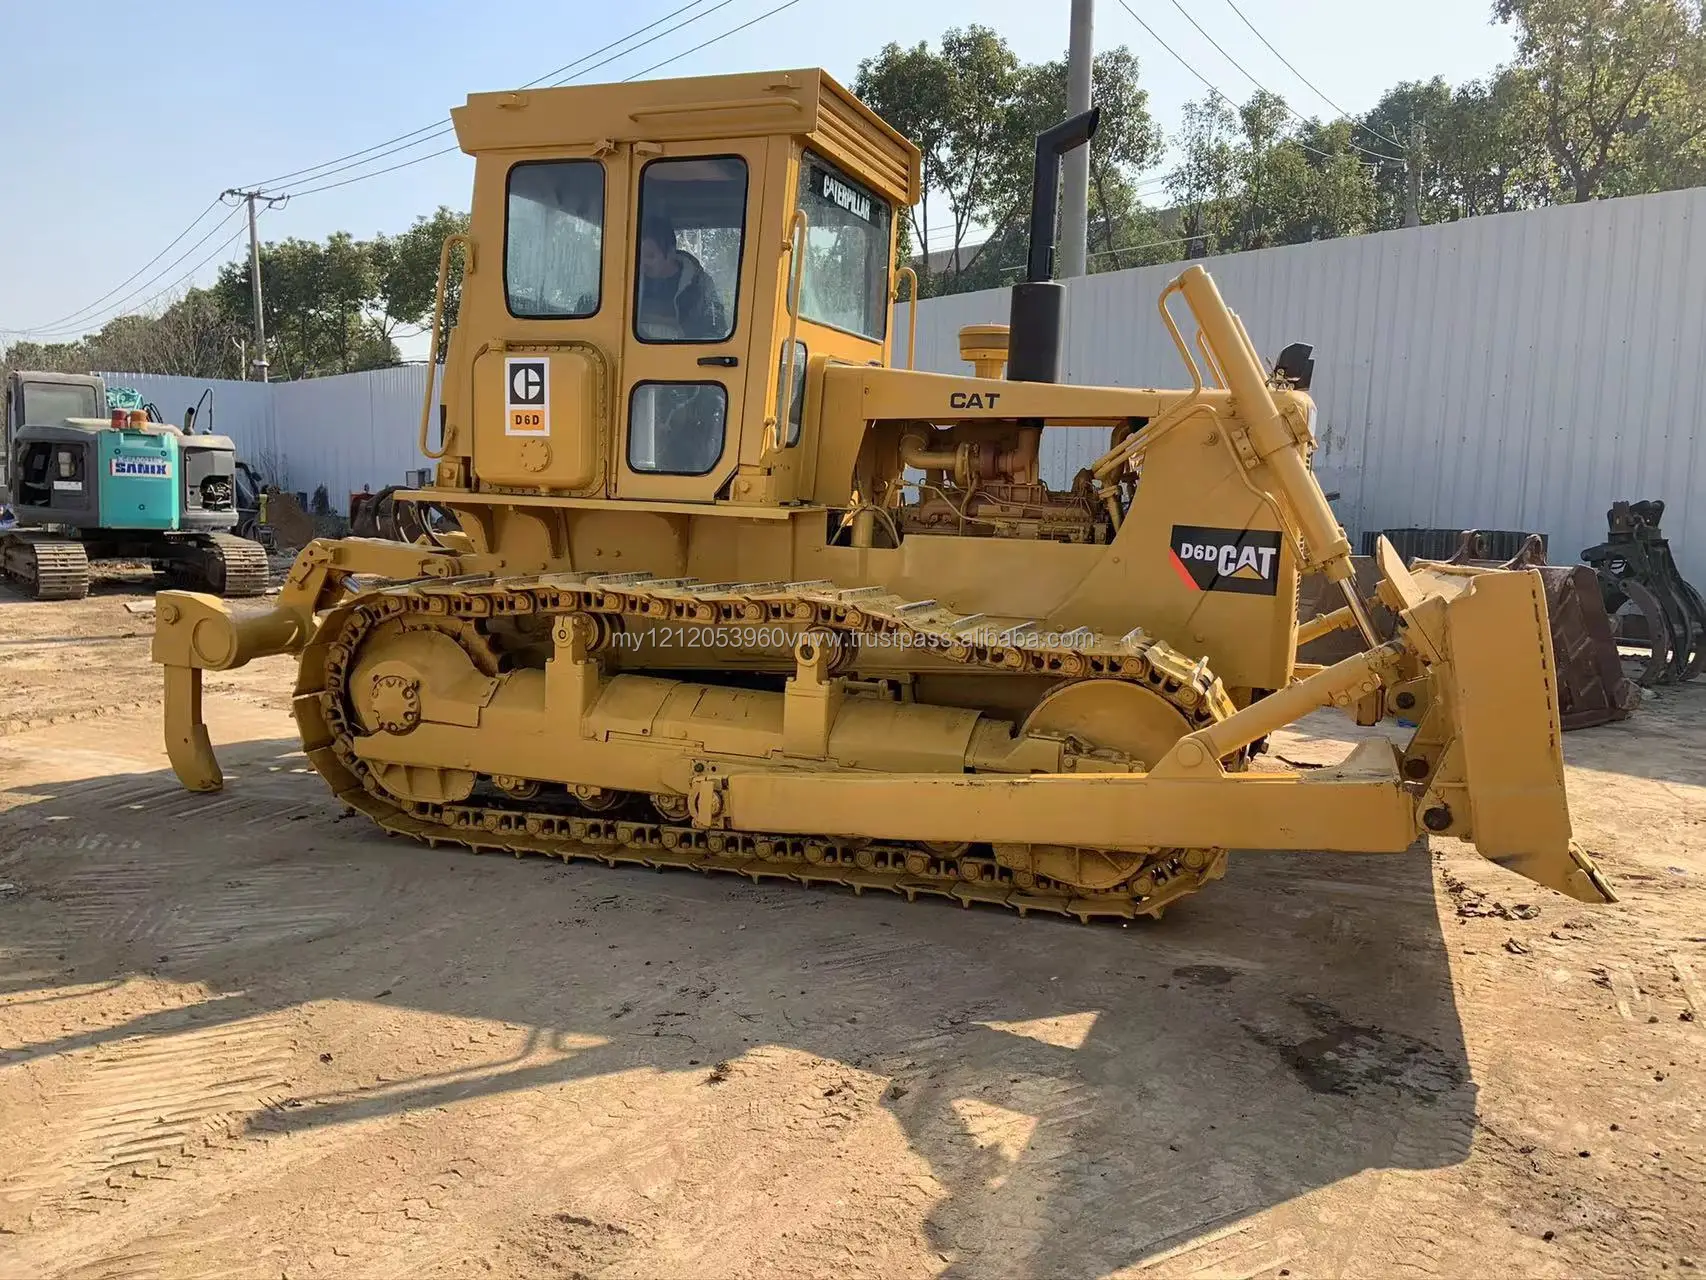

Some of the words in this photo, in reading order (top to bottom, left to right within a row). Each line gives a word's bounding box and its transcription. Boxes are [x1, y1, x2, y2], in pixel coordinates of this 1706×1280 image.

[823, 174, 871, 221] CATERPILLAR
[950, 392, 1001, 409] CAT
[515, 414, 540, 425] D6D
[1180, 542, 1218, 562] D6D
[1217, 544, 1277, 580] CAT
